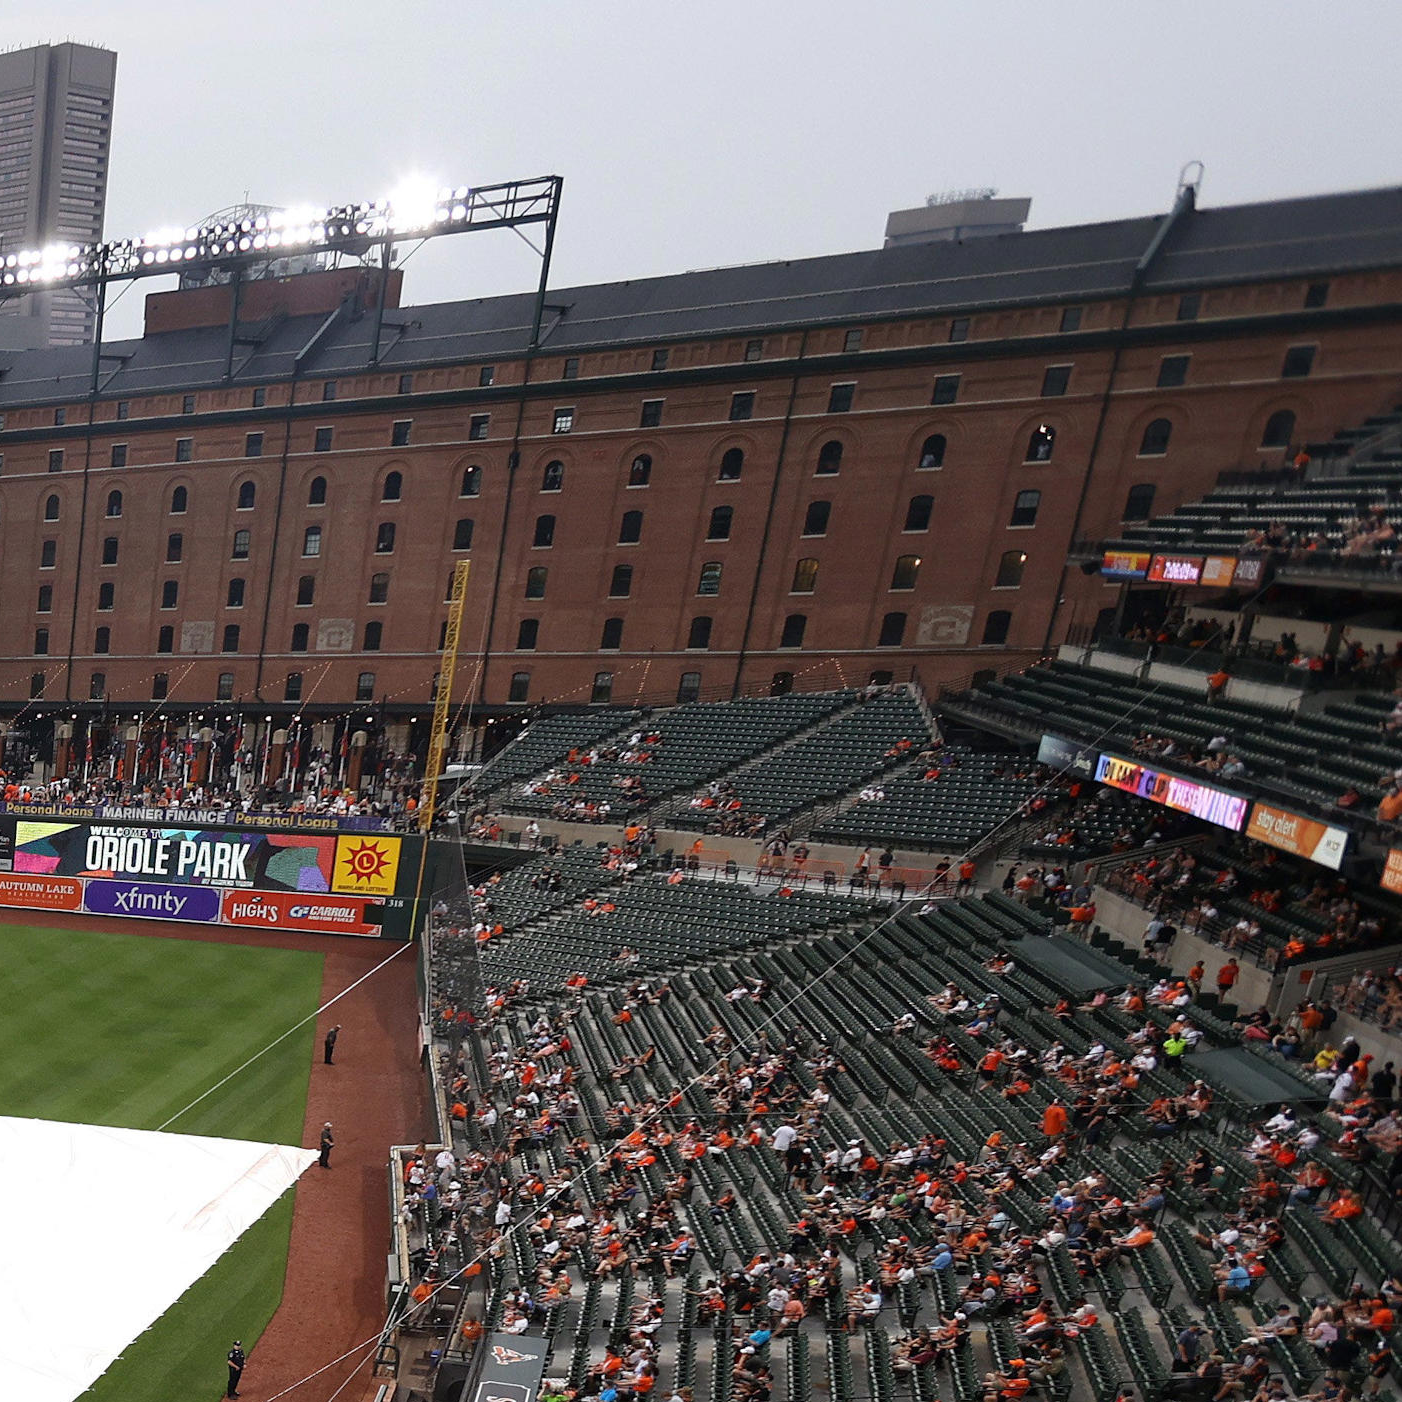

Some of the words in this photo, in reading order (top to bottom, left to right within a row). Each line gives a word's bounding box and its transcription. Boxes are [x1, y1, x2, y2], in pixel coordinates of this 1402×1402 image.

[6, 803, 56, 815] Personal
[59, 805, 93, 817] Loans
[102, 806, 163, 821] MARINER
[165, 808, 226, 824] FINANCE
[235, 814, 294, 827] Personal
[297, 816, 338, 829] Loans
[89, 825, 148, 838] WELCOME
[86, 835, 170, 875] ORIOLE
[177, 840, 251, 880] PARK
[46, 882, 75, 895] LAKE
[114, 886, 188, 912] xfinity
[232, 903, 279, 923] HIGH'S
[309, 905, 356, 918] CARROLL
